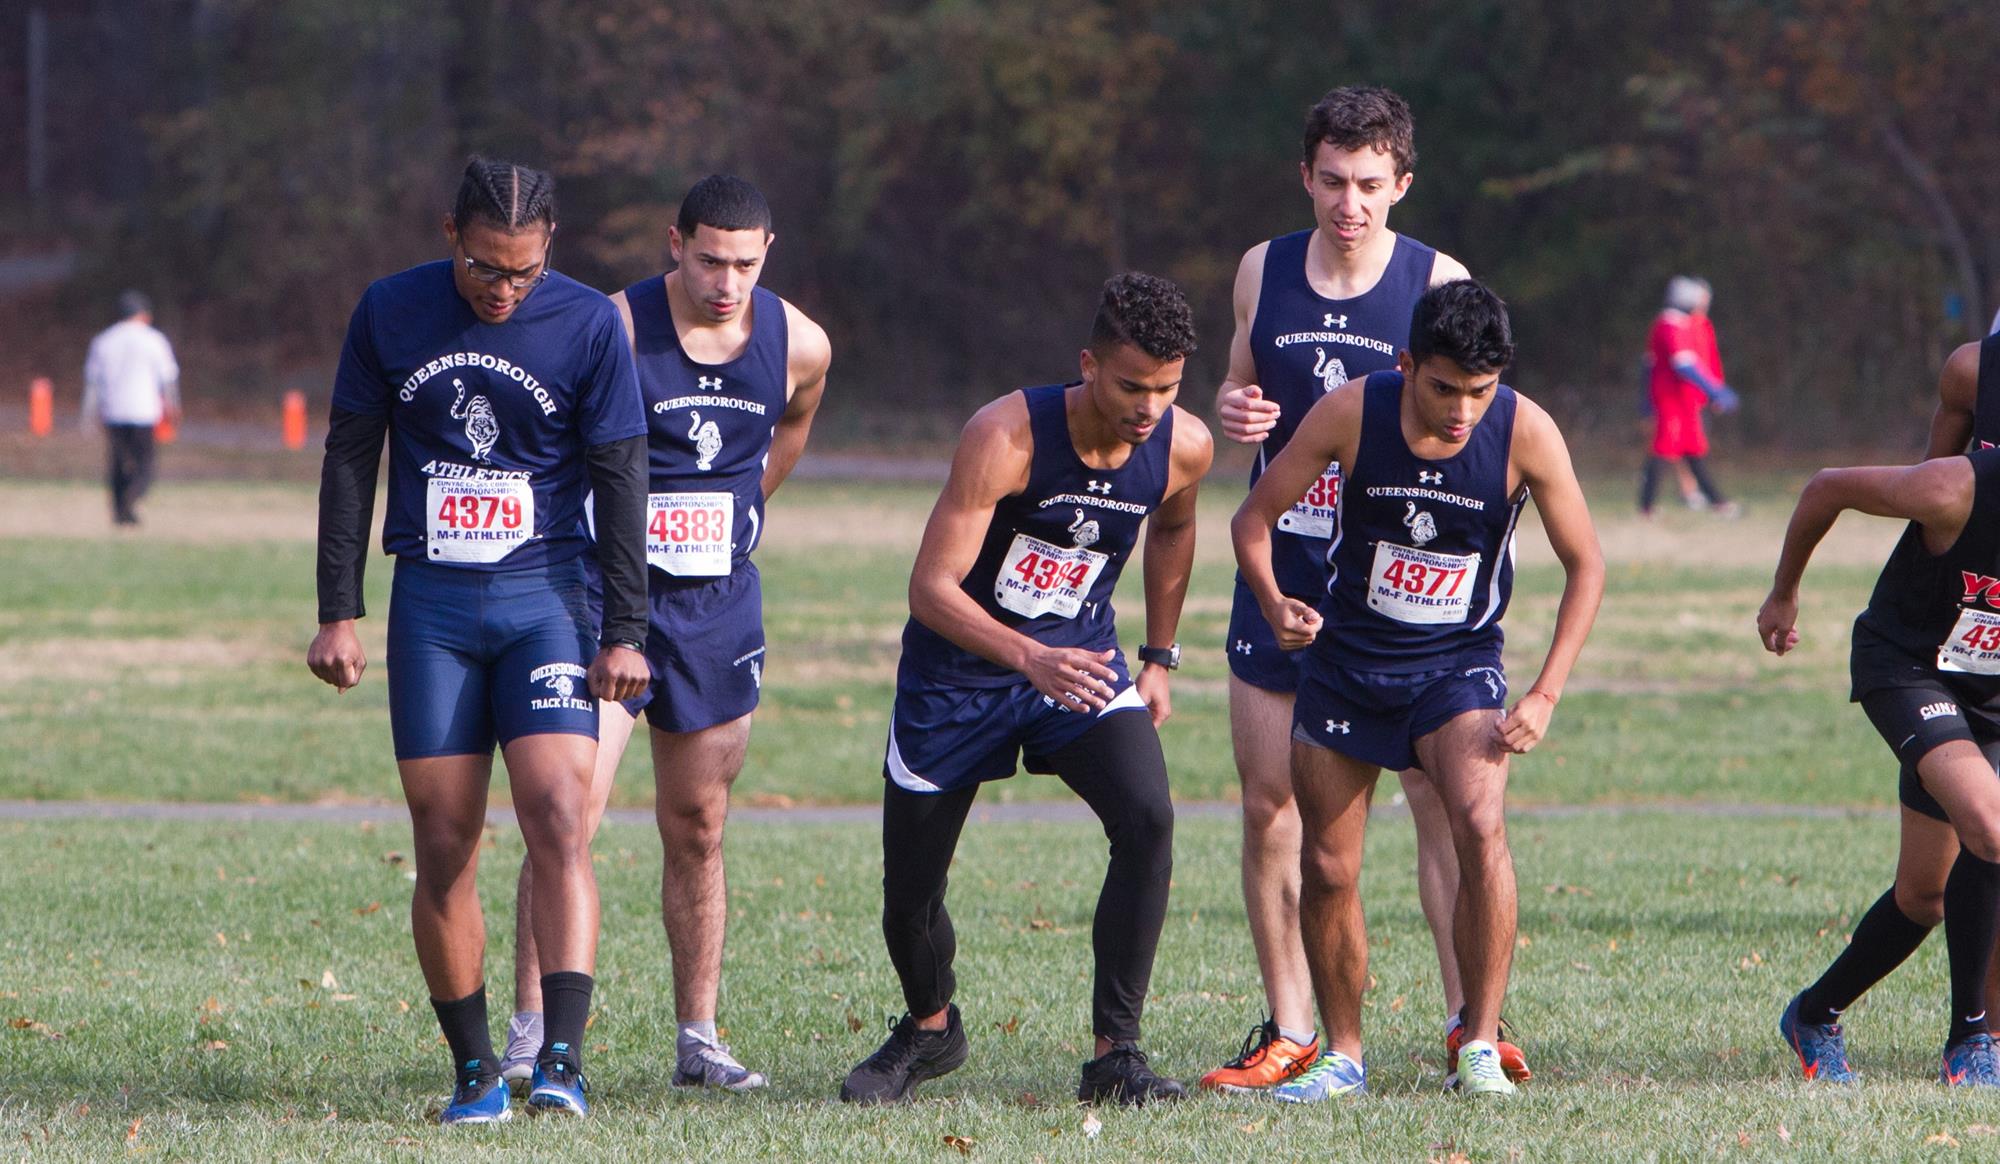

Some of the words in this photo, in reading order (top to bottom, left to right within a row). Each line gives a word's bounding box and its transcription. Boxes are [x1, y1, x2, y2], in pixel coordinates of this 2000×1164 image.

[1275, 332, 1394, 356] QUEENSBOROUGH
[400, 352, 557, 416] QUEENSBOROUGH
[653, 395, 766, 416] QUEENSBOROUGH
[421, 460, 533, 481] ATHLETICS
[441, 487, 519, 496] CHAMPIONSHIPS
[1366, 487, 1486, 511] QUEENSBOROUGH
[438, 495, 522, 529] 4379
[651, 501, 724, 509] CHAMPIONSHIPS
[1039, 493, 1147, 515] QUEENSBOROUGH
[437, 530, 460, 540] M-F
[464, 529, 524, 541] ATHLETIC
[648, 508, 725, 542] 4383
[648, 544, 670, 553] M-F
[675, 544, 725, 553] ATHLETIC
[1391, 551, 1467, 569] CHAMPIONSHIPS
[1014, 552, 1090, 590] 4384
[1383, 559, 1467, 597] 4377
[1006, 578, 1031, 593] M-F
[1377, 586, 1402, 600] M-F
[1404, 594, 1462, 607] ATHLETIC
[531, 697, 561, 710] TRACK
[562, 698, 570, 709] &
[571, 698, 593, 712] FIELD
